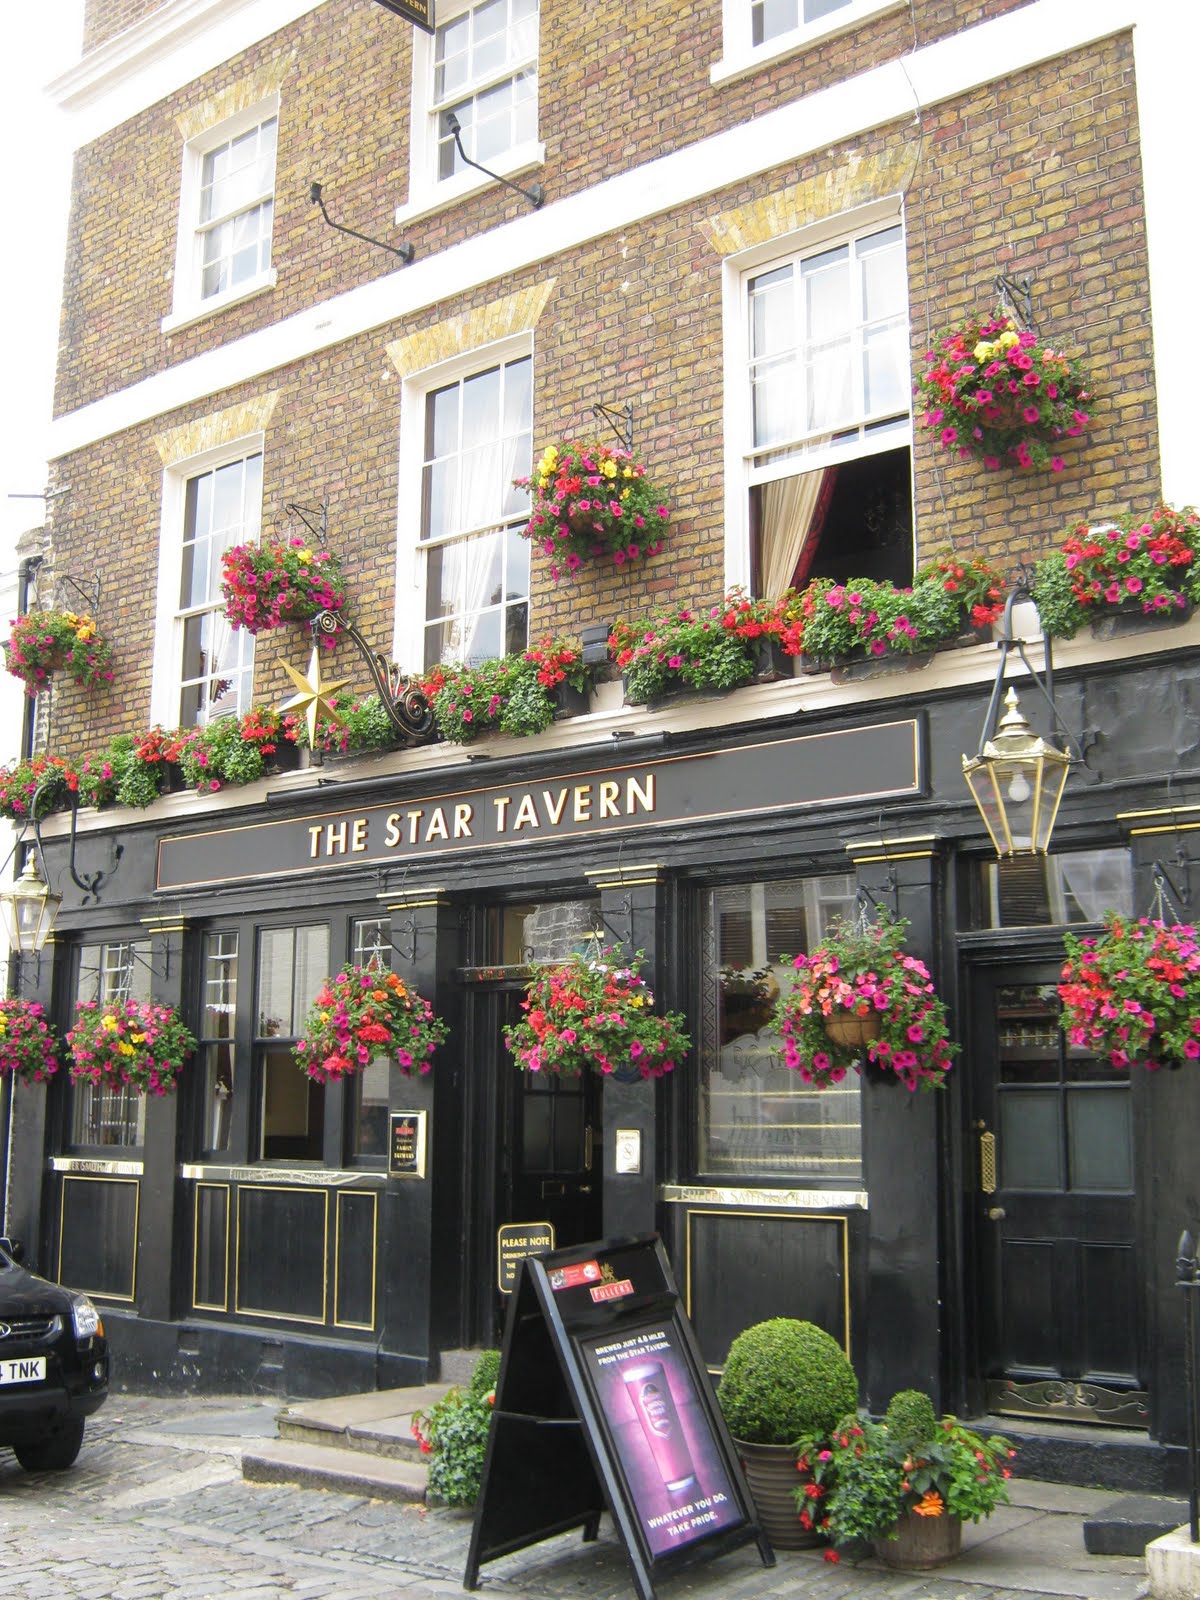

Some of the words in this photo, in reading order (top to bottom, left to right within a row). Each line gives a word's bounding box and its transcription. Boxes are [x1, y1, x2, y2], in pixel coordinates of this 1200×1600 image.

[308, 818, 368, 858] THE
[384, 803, 473, 848] STAR
[493, 774, 656, 833] TAVERN
[502, 1238, 527, 1248] PLEASE
[530, 1236, 550, 1246] NOTE
[595, 1342, 622, 1355] BREWED
[623, 1338, 637, 1349] JUST
[648, 1331, 666, 1341] MILES
[597, 1355, 617, 1366] FROM
[616, 1351, 629, 1361] THE
[629, 1347, 646, 1357] STAR
[9, 1361, 39, 1380] TNK
[647, 1504, 694, 1529] WHATEVER
[694, 1496, 712, 1510] YOU
[667, 1521, 690, 1537] TAKE
